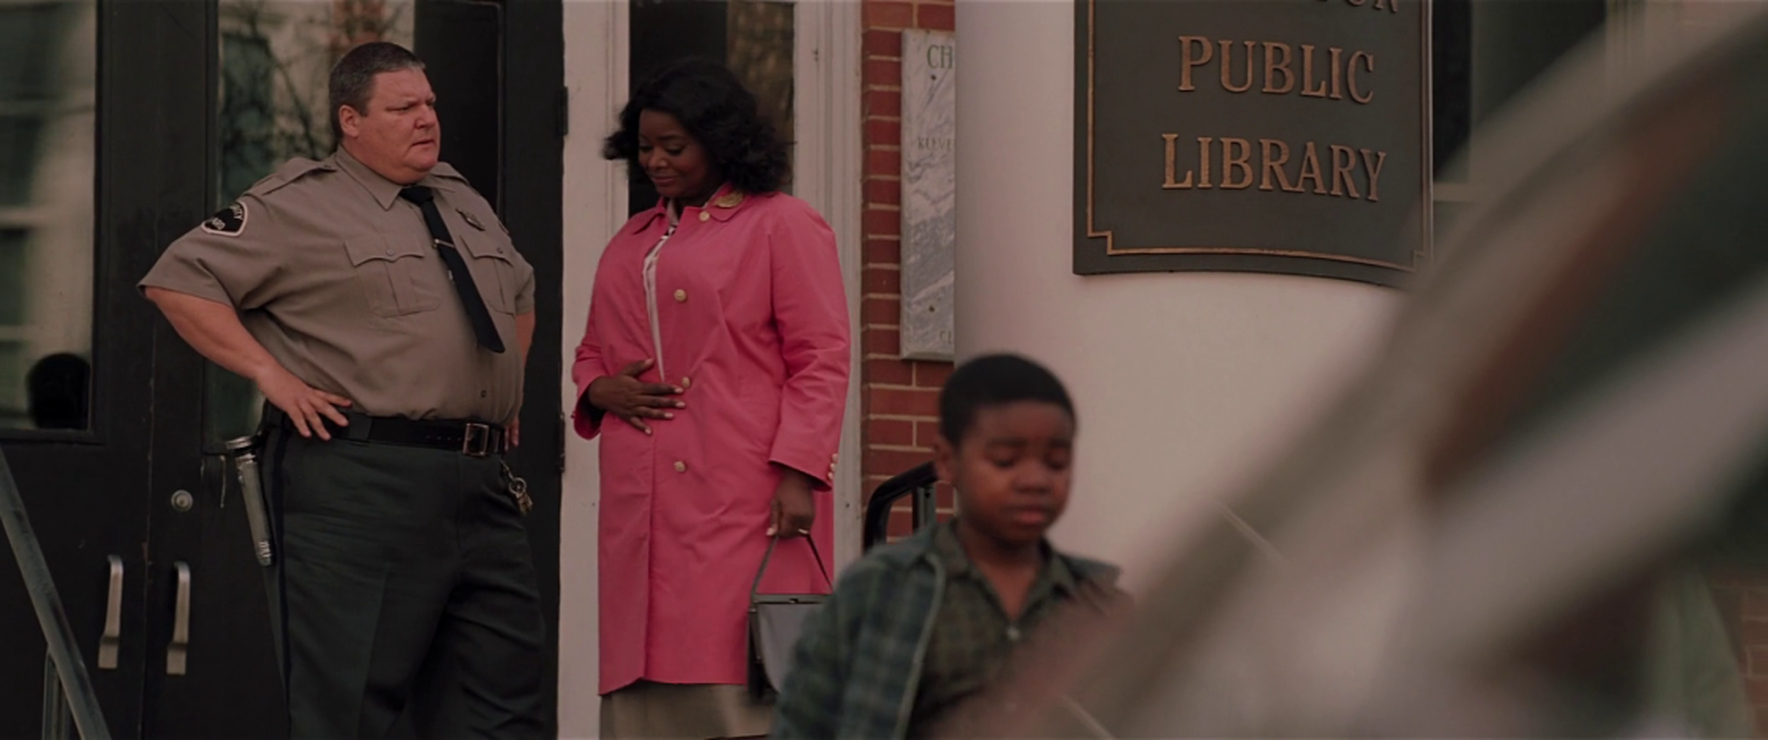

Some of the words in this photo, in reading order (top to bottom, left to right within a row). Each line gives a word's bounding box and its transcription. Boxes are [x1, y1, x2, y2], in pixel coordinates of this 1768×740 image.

[927, 44, 953, 69] CH
[1177, 35, 1374, 104] PUBLIC
[1161, 133, 1387, 202] LIBRARY
